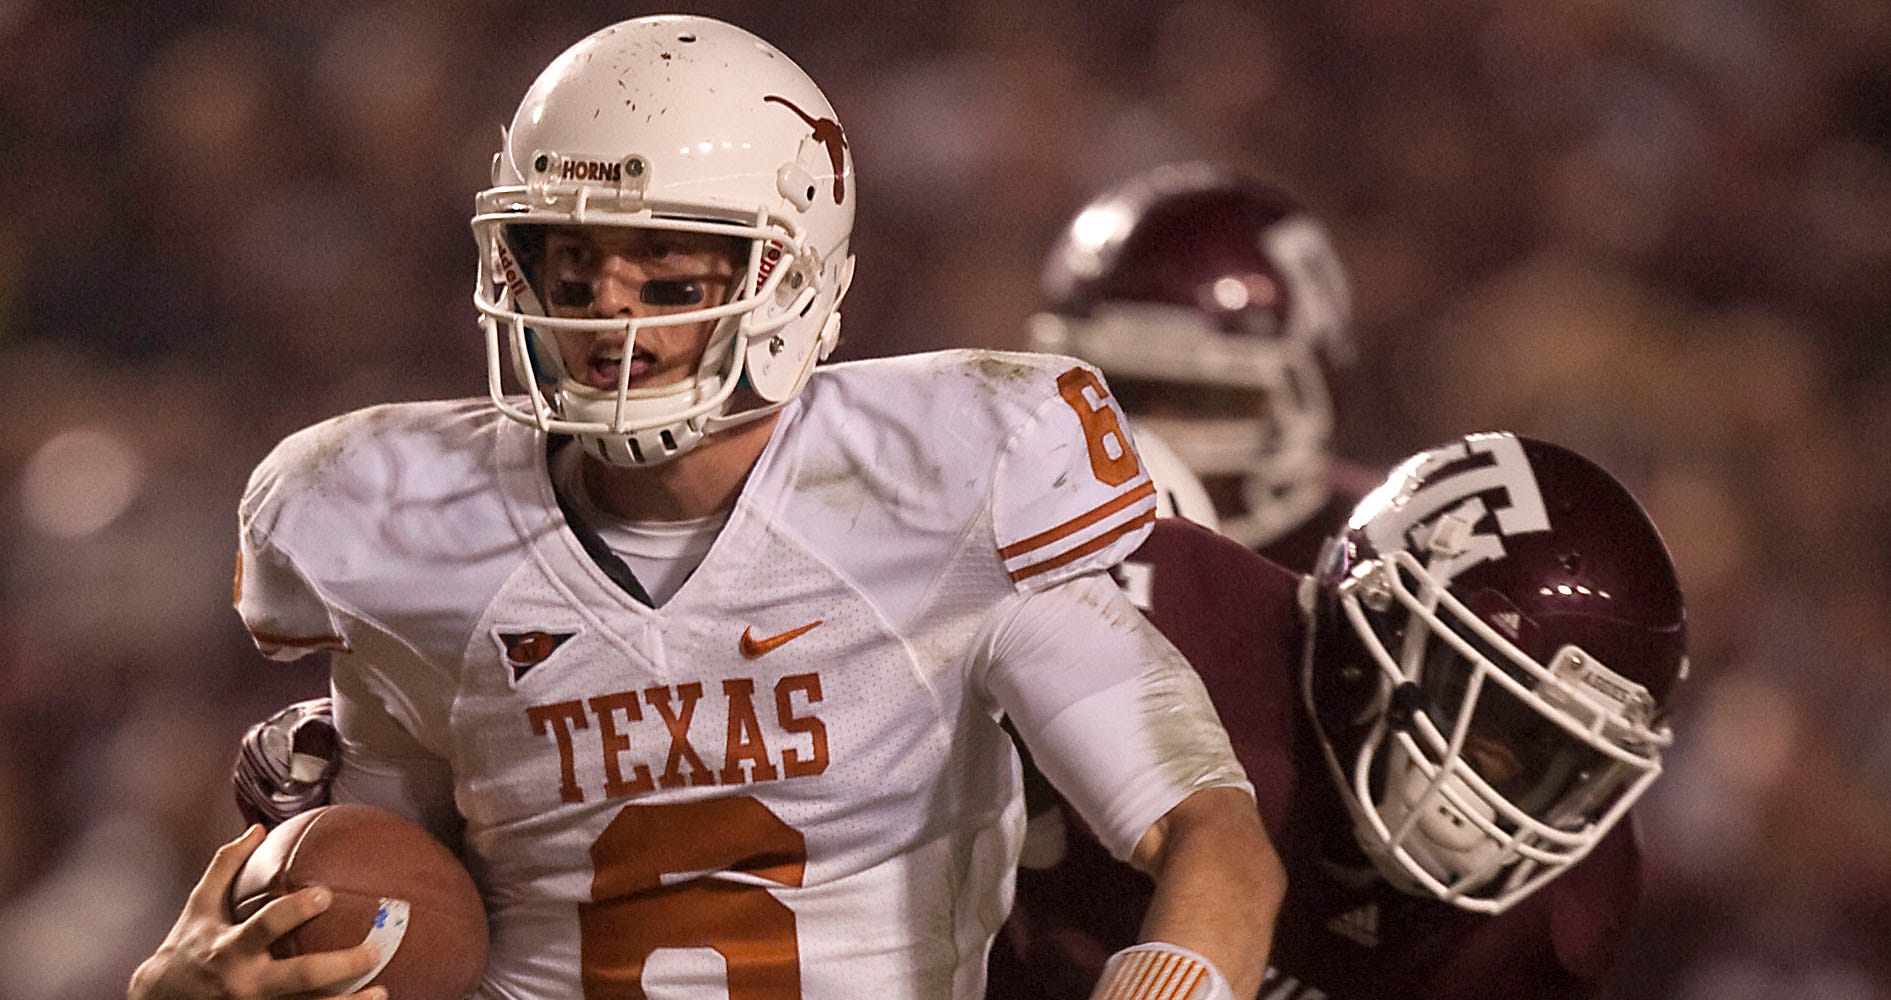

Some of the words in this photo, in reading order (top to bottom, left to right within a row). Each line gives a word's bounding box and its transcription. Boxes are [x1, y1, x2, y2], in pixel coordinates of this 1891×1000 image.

[563, 161, 621, 181] HORNS
[1056, 366, 1140, 487] 6
[526, 673, 830, 802] TEXAS
